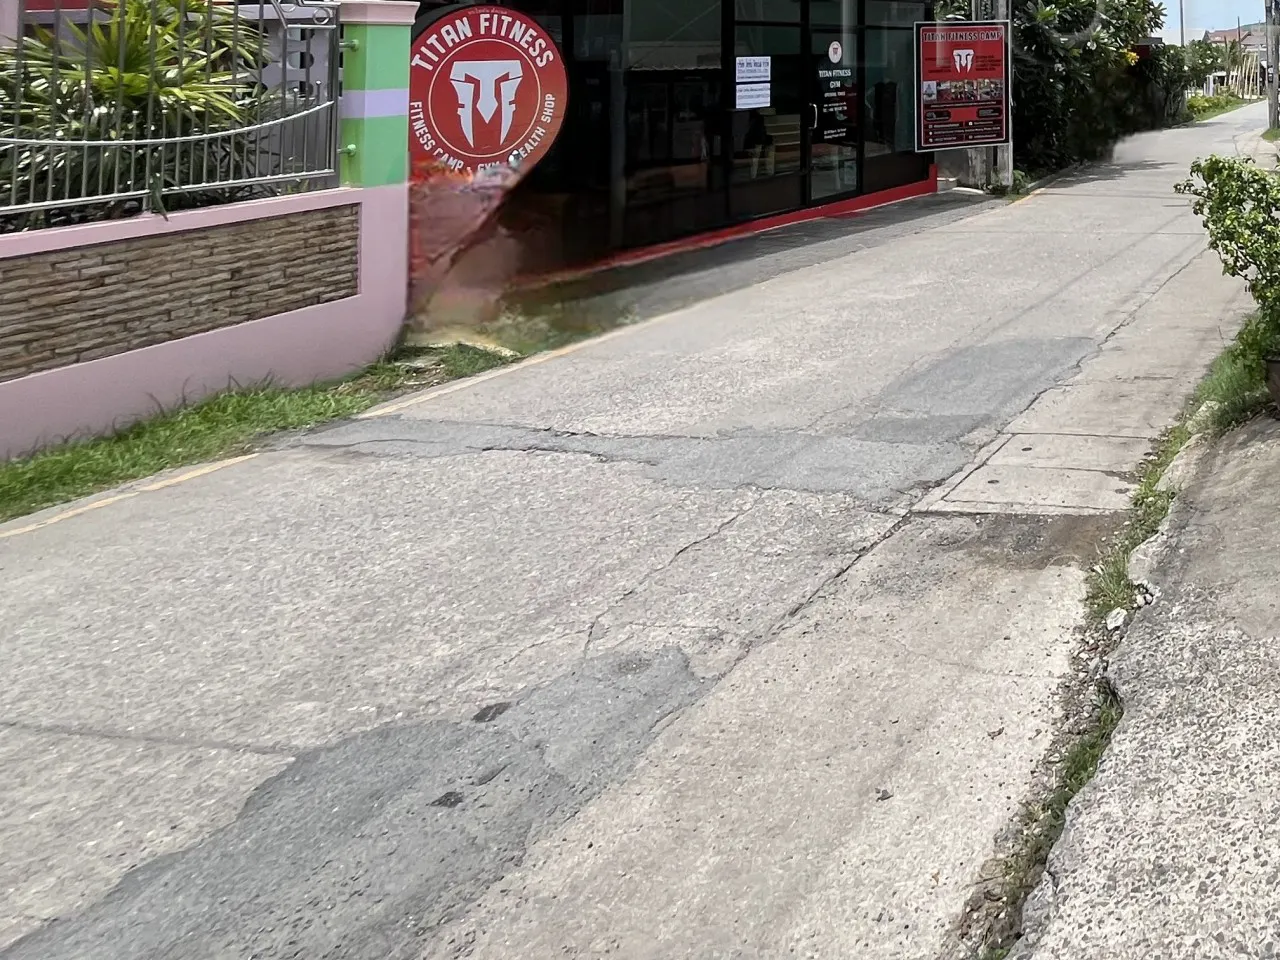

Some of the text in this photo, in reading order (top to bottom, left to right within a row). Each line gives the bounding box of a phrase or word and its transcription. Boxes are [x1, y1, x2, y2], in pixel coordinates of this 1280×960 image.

[411, 13, 554, 71] TITAN FITNESS
[923, 31, 946, 42] TITAN
[948, 31, 978, 41] FITNESS
[410, 101, 436, 151] FITNESS
[519, 126, 546, 161] EALTH
[541, 93, 556, 123] SHOP
